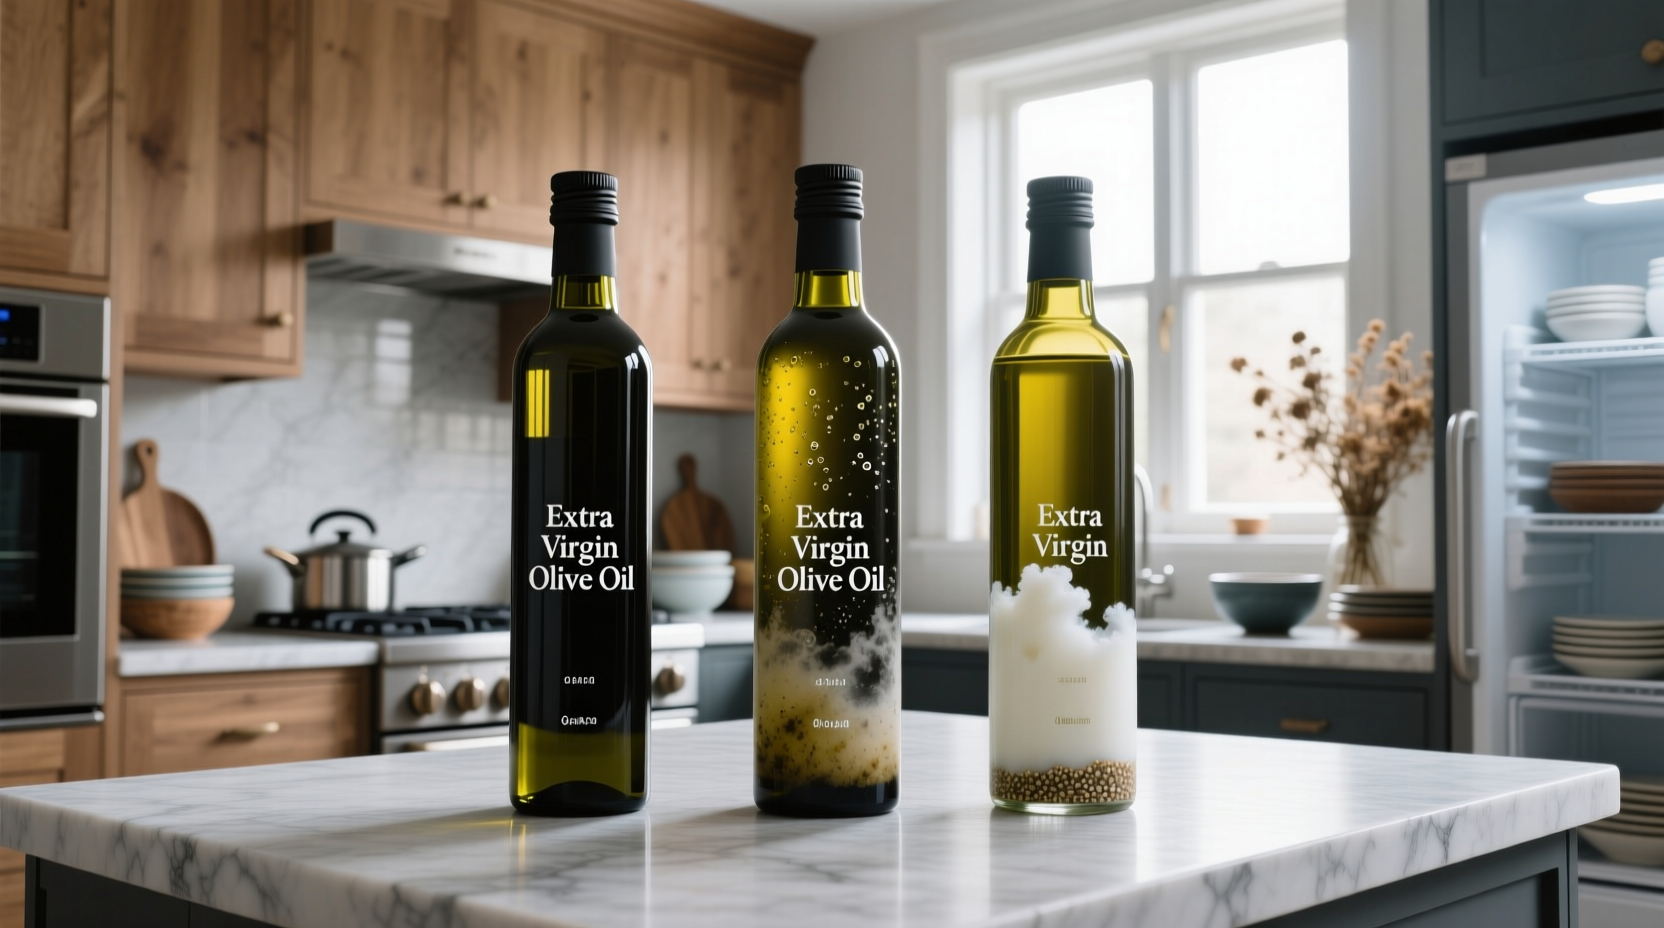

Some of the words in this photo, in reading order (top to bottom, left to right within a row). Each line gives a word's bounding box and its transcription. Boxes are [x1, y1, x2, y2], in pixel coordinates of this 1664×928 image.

[545, 504, 614, 528] Extra
[795, 504, 864, 528] Extra
[1037, 503, 1103, 527] Extra
[540, 534, 619, 566] Virgin
[790, 535, 870, 567] Virgin
[1032, 533, 1108, 565] Virgin
[528, 565, 593, 591] Olive
[599, 565, 635, 591] Oil
[777, 565, 843, 591] Olive
[848, 565, 885, 591] Oil
